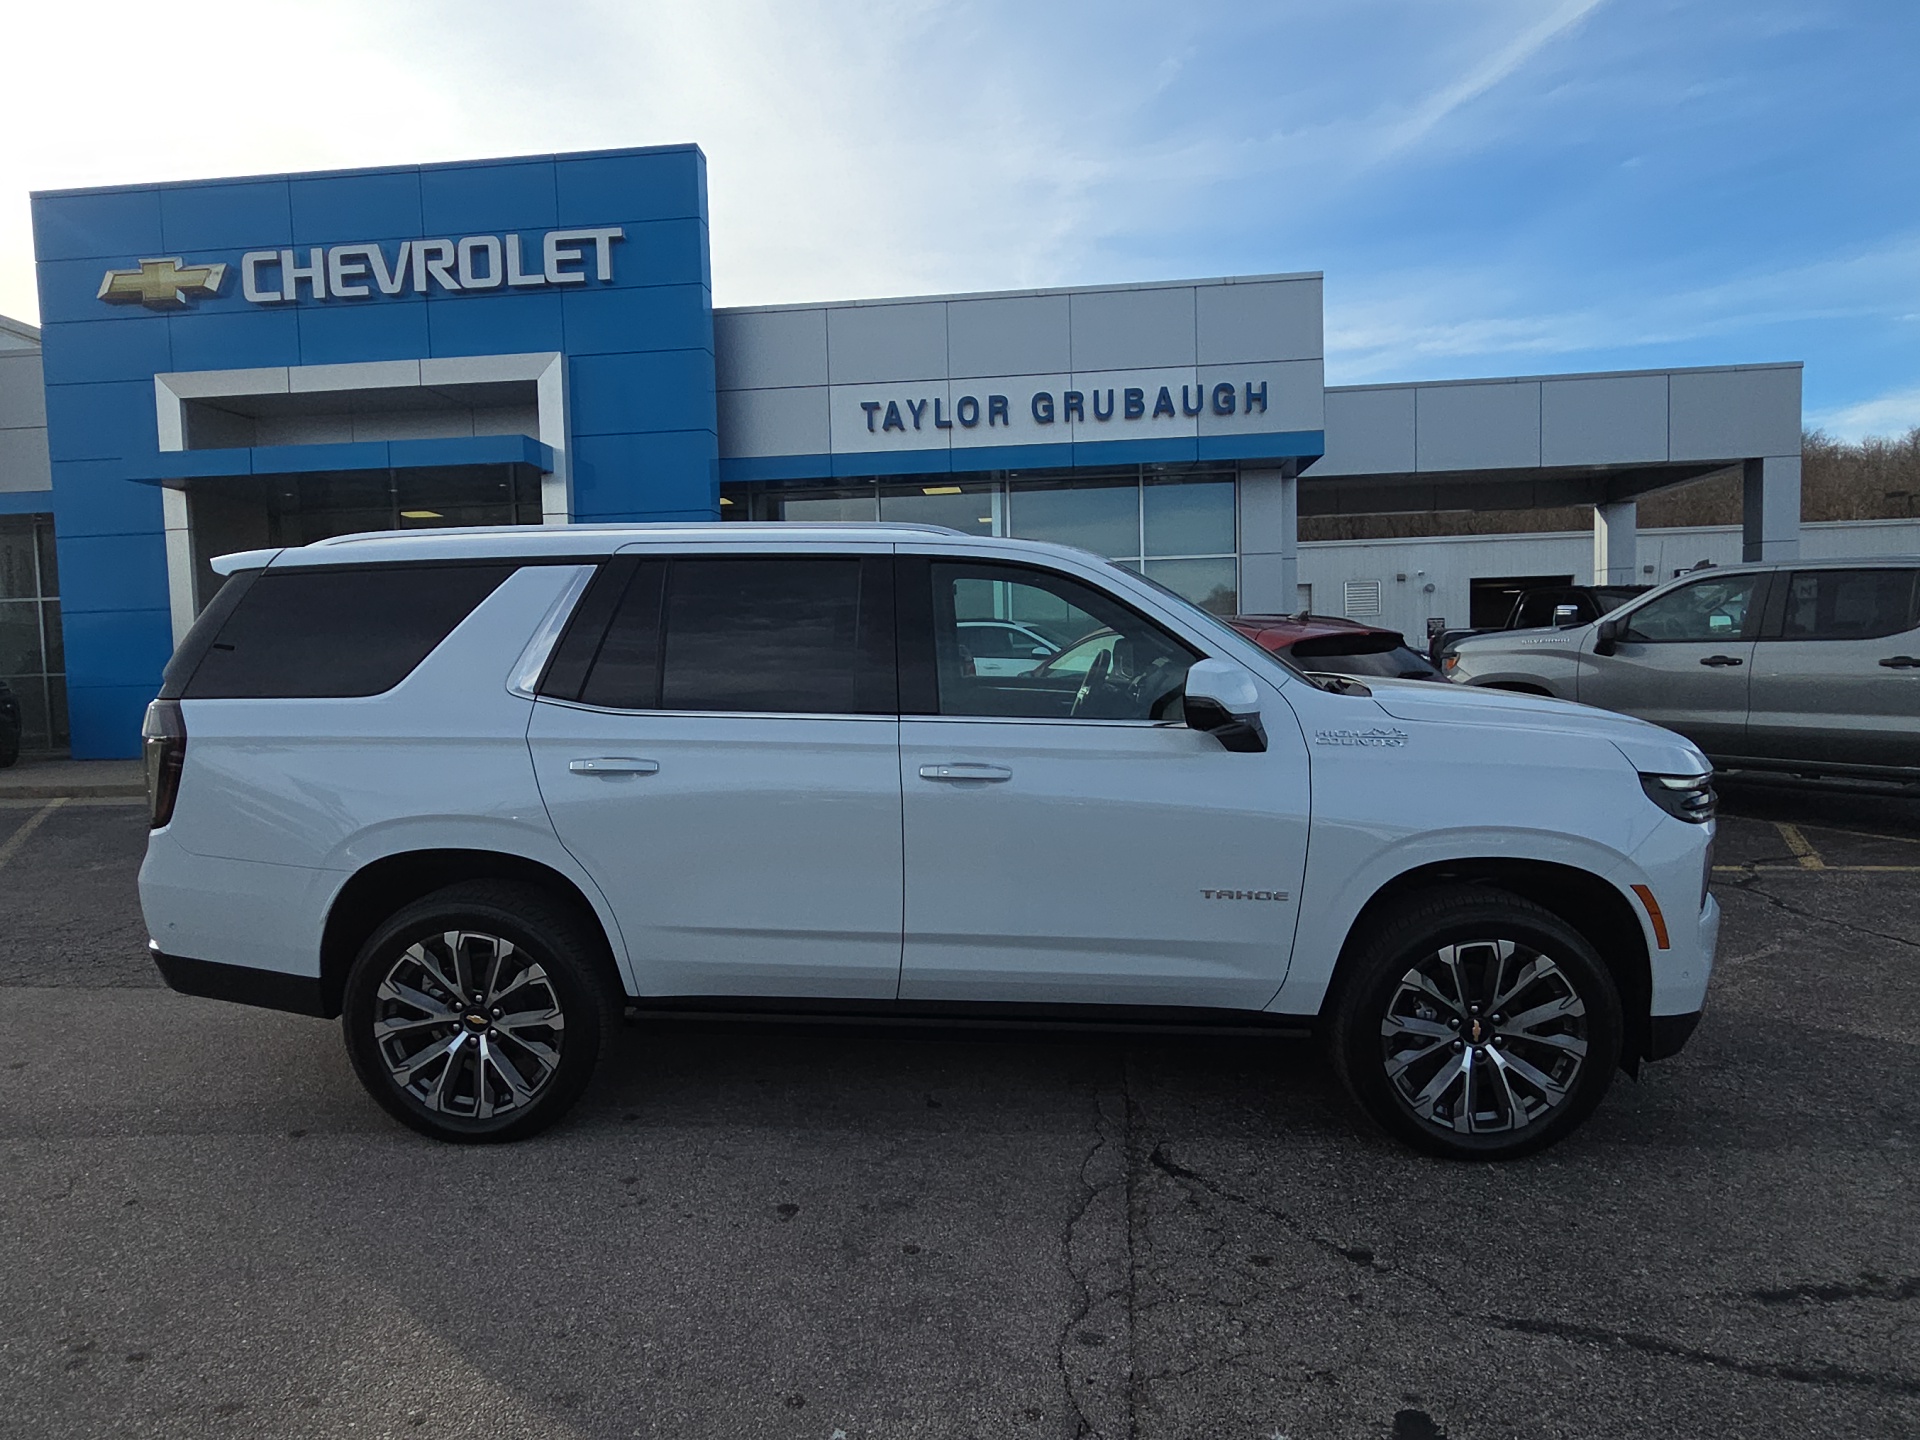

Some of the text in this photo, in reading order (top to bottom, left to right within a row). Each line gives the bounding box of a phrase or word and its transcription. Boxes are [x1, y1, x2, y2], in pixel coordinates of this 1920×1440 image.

[241, 227, 624, 303] CHEVROLET
[860, 381, 1268, 432] TAYLOR GRUBAUGH
[1314, 729, 1361, 738] HIGH
[1315, 737, 1405, 748] COUNTRY
[1199, 889, 1290, 902] TAHOE
